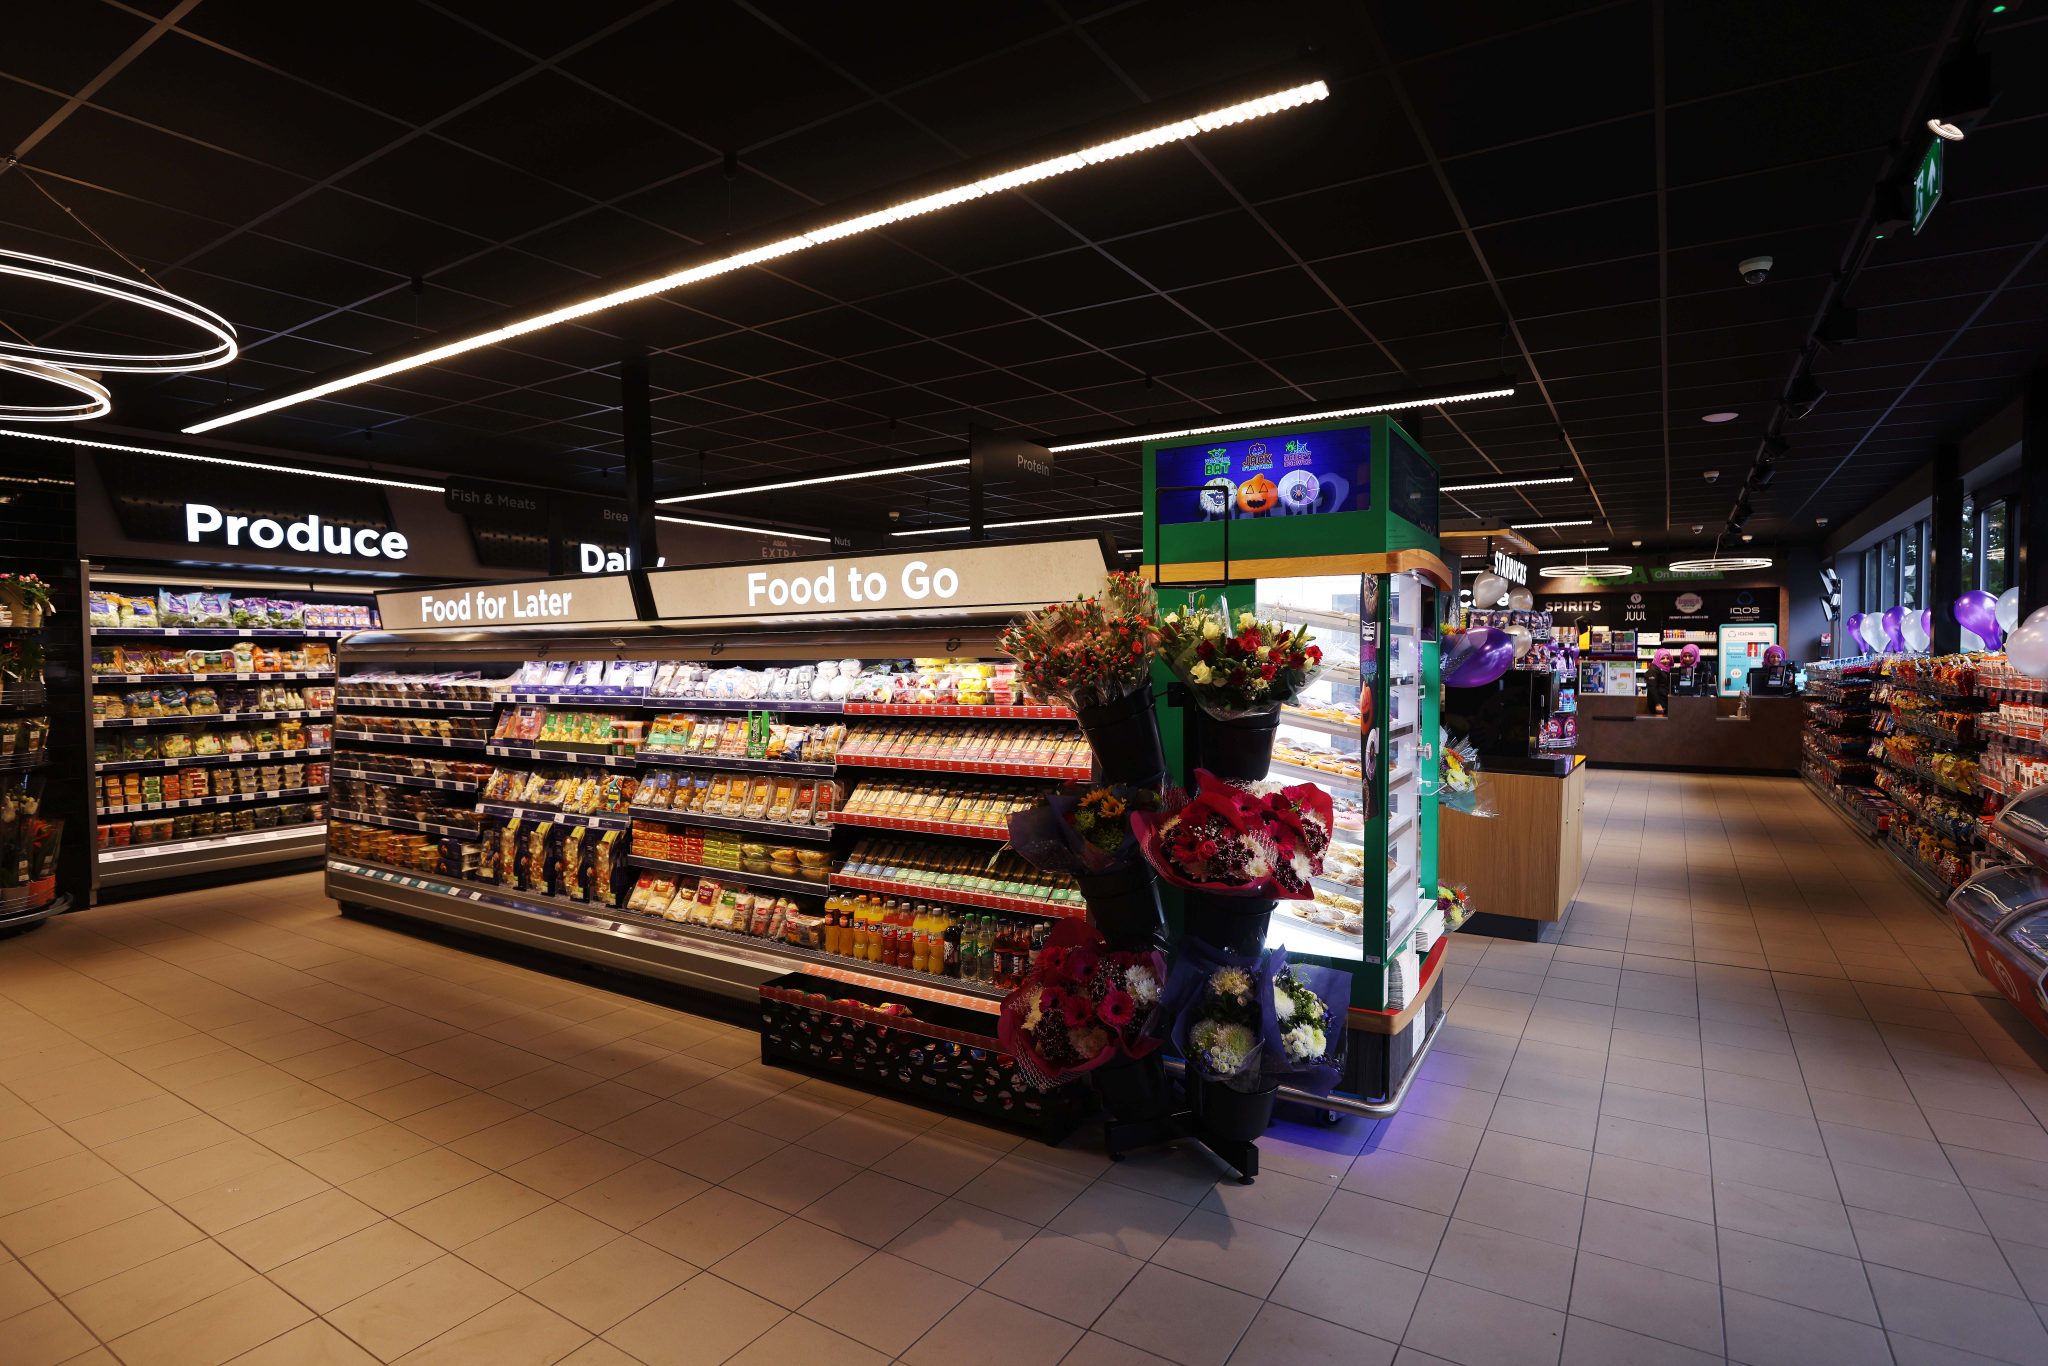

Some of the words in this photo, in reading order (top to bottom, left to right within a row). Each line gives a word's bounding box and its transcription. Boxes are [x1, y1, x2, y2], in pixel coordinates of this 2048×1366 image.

[1016, 454, 1051, 477] Protein
[1241, 453, 1273, 467] JACK
[1205, 463, 1230, 475] BAT
[450, 488, 481, 505] Fish
[484, 492, 494, 505] &
[497, 495, 537, 511] Meats
[603, 509, 629, 523] Brea
[185, 503, 409, 561] Produce
[772, 539, 788, 547] ASDA
[834, 535, 851, 547] Nuts
[761, 547, 799, 559] EXTRA
[1494, 551, 1527, 586] STARBUCKS
[1654, 569, 1670, 580] On
[1691, 569, 1720, 579] Move
[748, 568, 836, 607] Food
[848, 567, 888, 602] to
[901, 560, 959, 599] Go
[420, 594, 471, 623] Food
[475, 592, 508, 620] for
[512, 589, 573, 618] Later
[1545, 601, 1602, 613] SPIRITS
[1729, 606, 1760, 615] IQOS
[1624, 610, 1647, 622] JUUL
